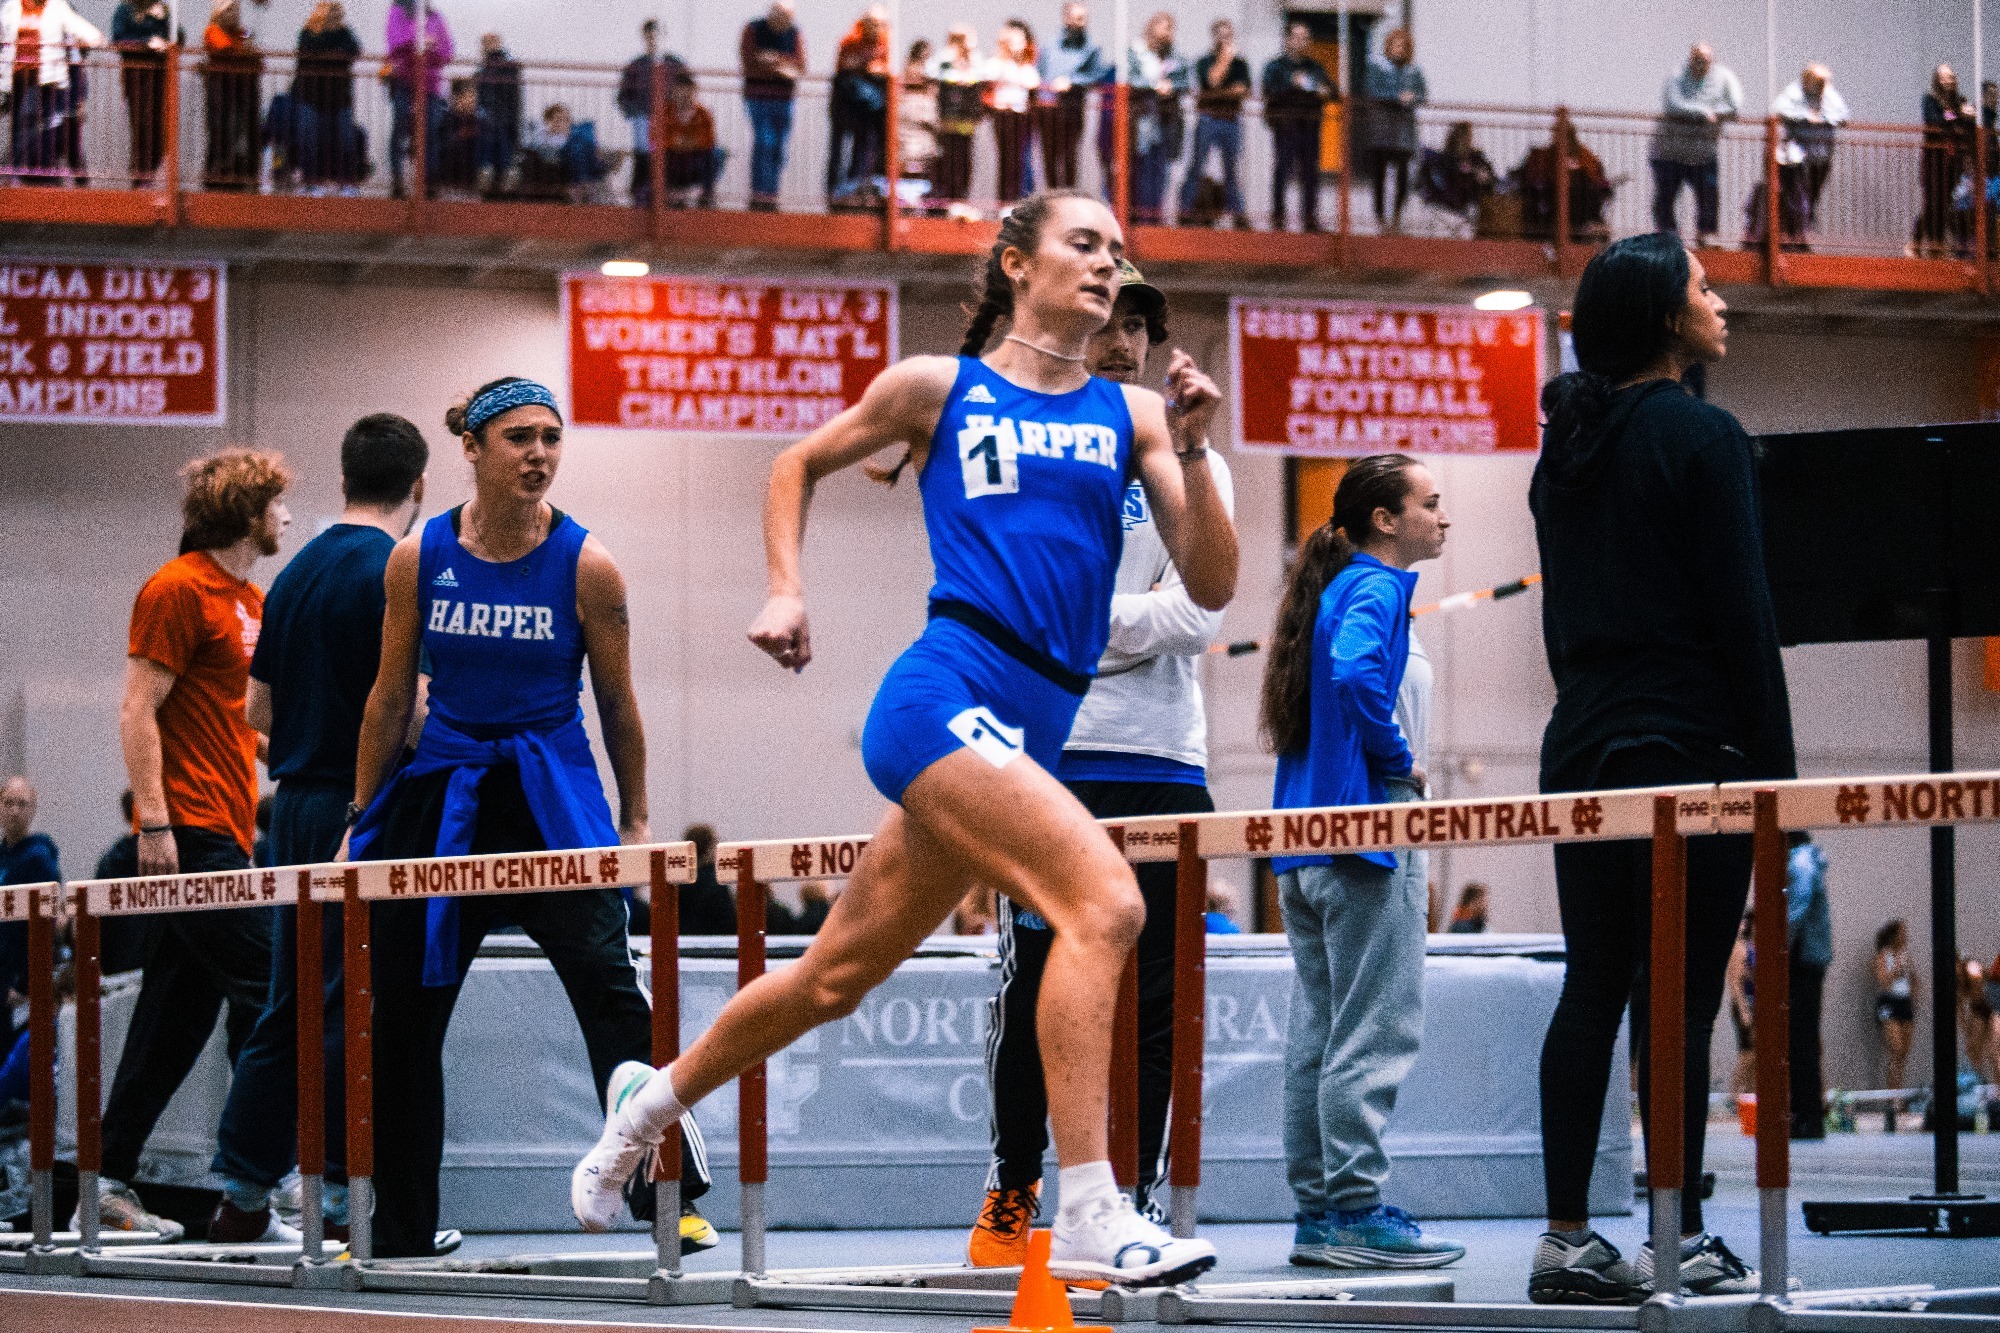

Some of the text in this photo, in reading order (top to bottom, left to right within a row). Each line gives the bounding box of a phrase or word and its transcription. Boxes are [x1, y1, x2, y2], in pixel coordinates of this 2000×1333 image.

[46, 304, 194, 338] INDOOR
[1327, 313, 1425, 343] NCAA
[83, 341, 204, 375] FIELD
[619, 355, 843, 394] TRIATHLON
[1298, 344, 1484, 381] NATIONAL
[1290, 378, 1492, 416] FOOTBALL
[1286, 413, 1496, 450] CHAMPIONS
[968, 434, 1002, 485] 1
[428, 599, 555, 640] HARPER
[1283, 810, 1393, 849] NORTH
[1405, 801, 1560, 843] CENTRAL
[127, 879, 178, 909] NORTH
[183, 873, 256, 904] CENTRAL
[414, 860, 485, 893] NORTH
[493, 854, 591, 888] CENTRAL
[841, 997, 986, 1046] NORT
